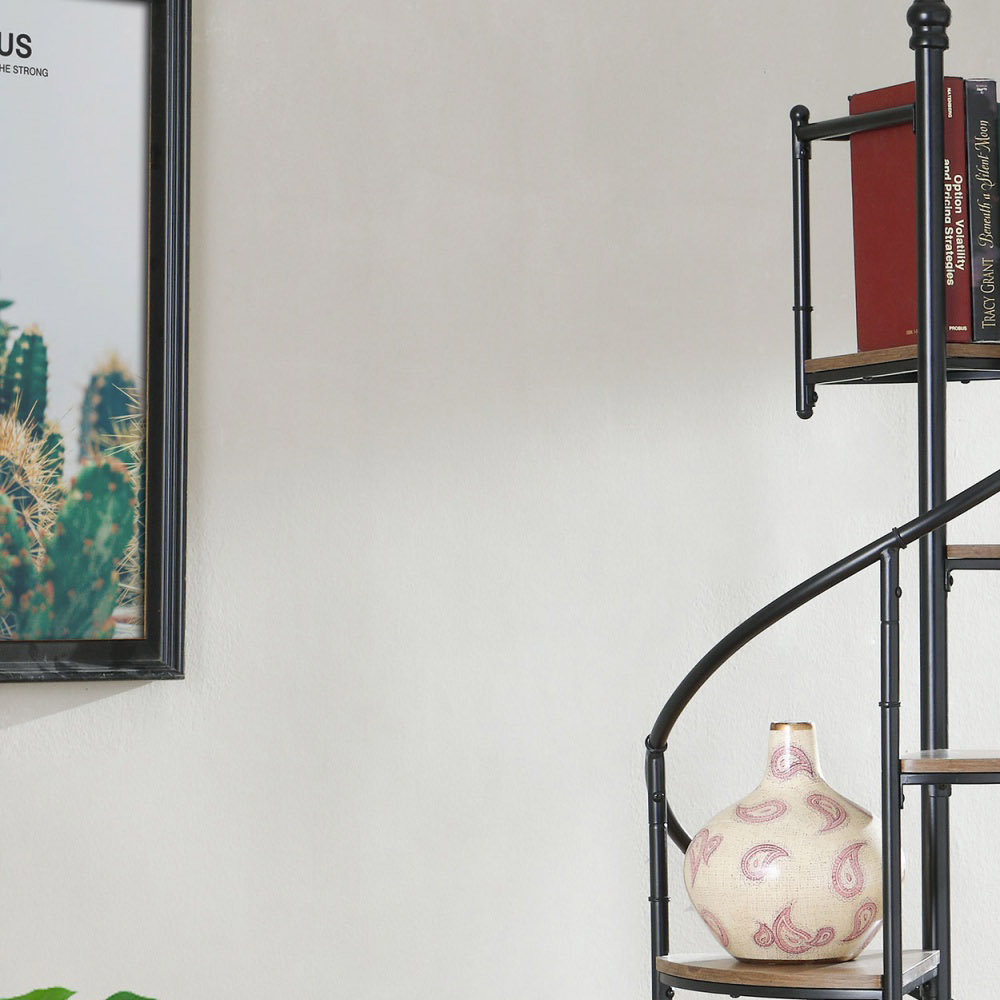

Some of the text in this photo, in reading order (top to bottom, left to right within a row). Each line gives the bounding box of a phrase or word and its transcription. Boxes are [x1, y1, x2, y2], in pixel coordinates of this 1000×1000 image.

[12, 64, 49, 77] STRONG
[974, 120, 991, 152] Moon
[944, 159, 952, 181] and
[975, 152, 996, 191] Silent
[953, 174, 966, 271] Option Volatility
[976, 199, 994, 249] Beneath
[944, 227, 955, 286] Strategies
[980, 257, 996, 329] TRACY GRANT
